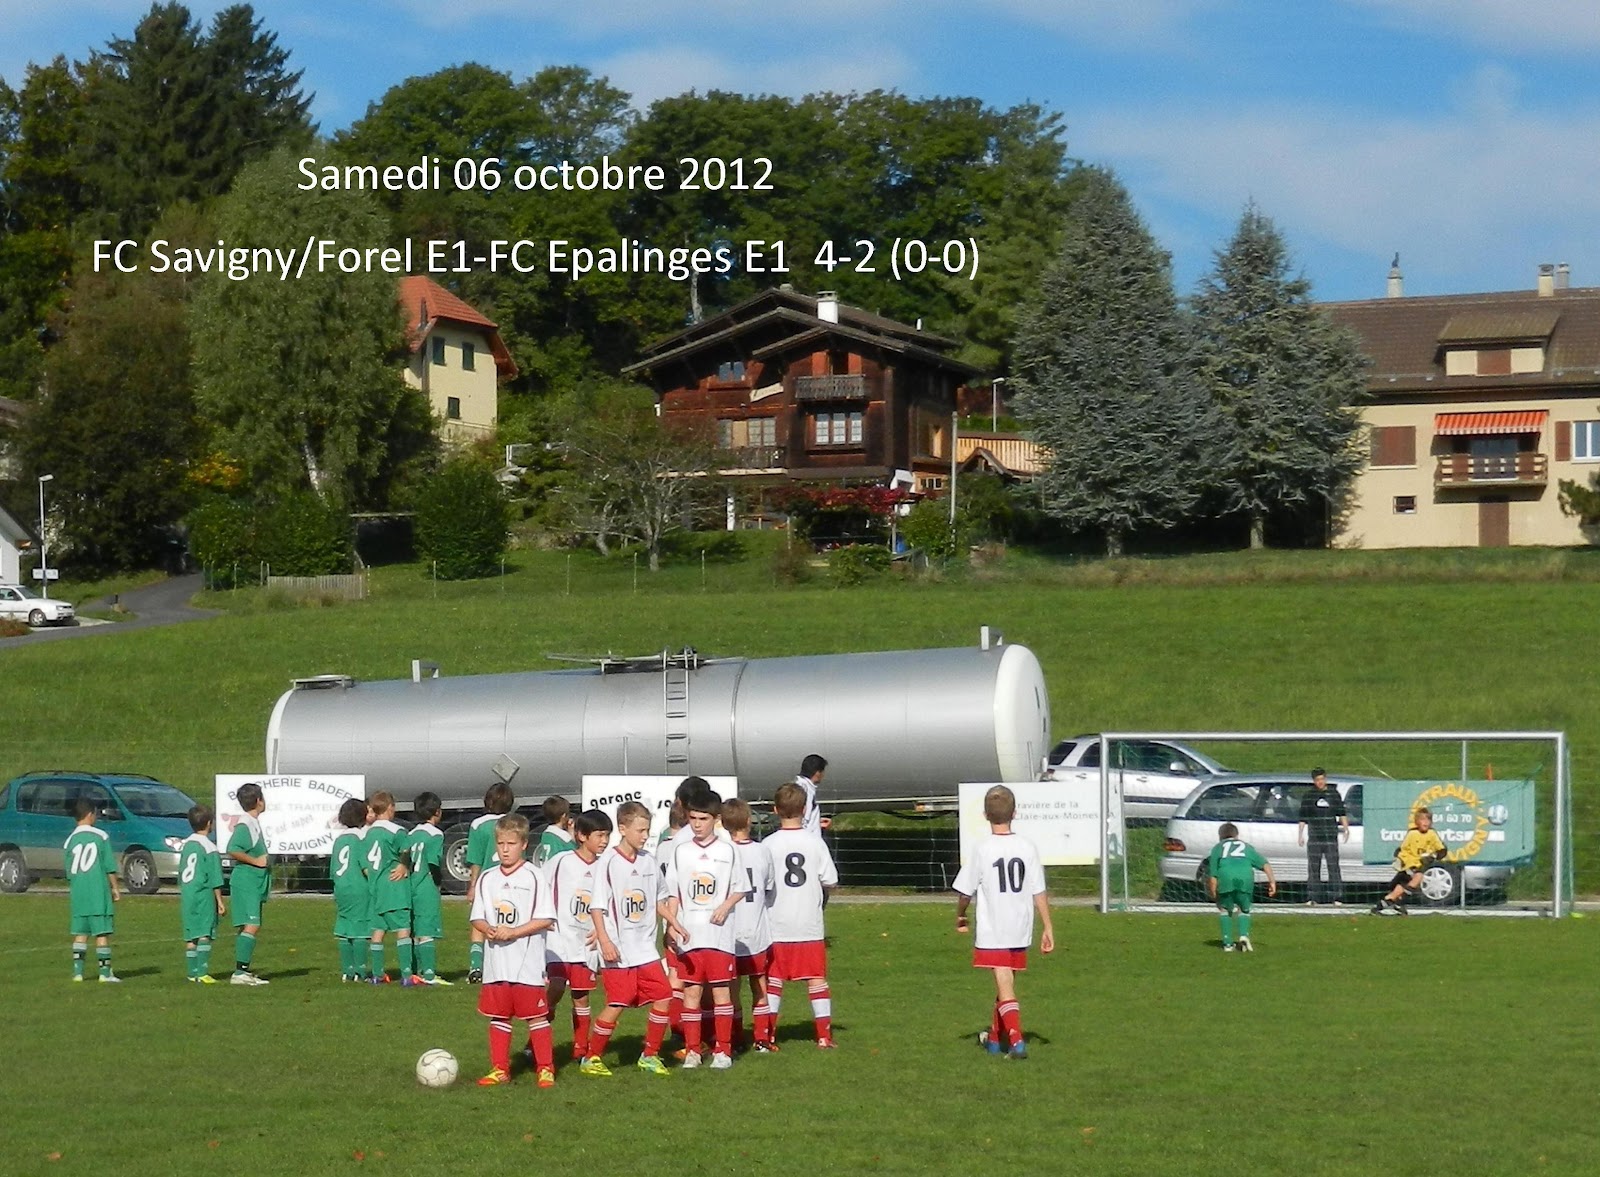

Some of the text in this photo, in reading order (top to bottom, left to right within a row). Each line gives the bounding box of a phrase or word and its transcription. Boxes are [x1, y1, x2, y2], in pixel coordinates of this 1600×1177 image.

[1016, 801, 1079, 809] ravière de la
[278, 832, 334, 851] SAVIGNY
[367, 839, 383, 871] 4
[1220, 840, 1247, 858] 12
[70, 841, 98, 875] 10
[181, 852, 198, 884] 8
[336, 844, 351, 877] 9
[783, 852, 807, 888] 8
[690, 879, 717, 900] jhd
[992, 857, 1026, 893] 10
[623, 896, 646, 918] jhd
